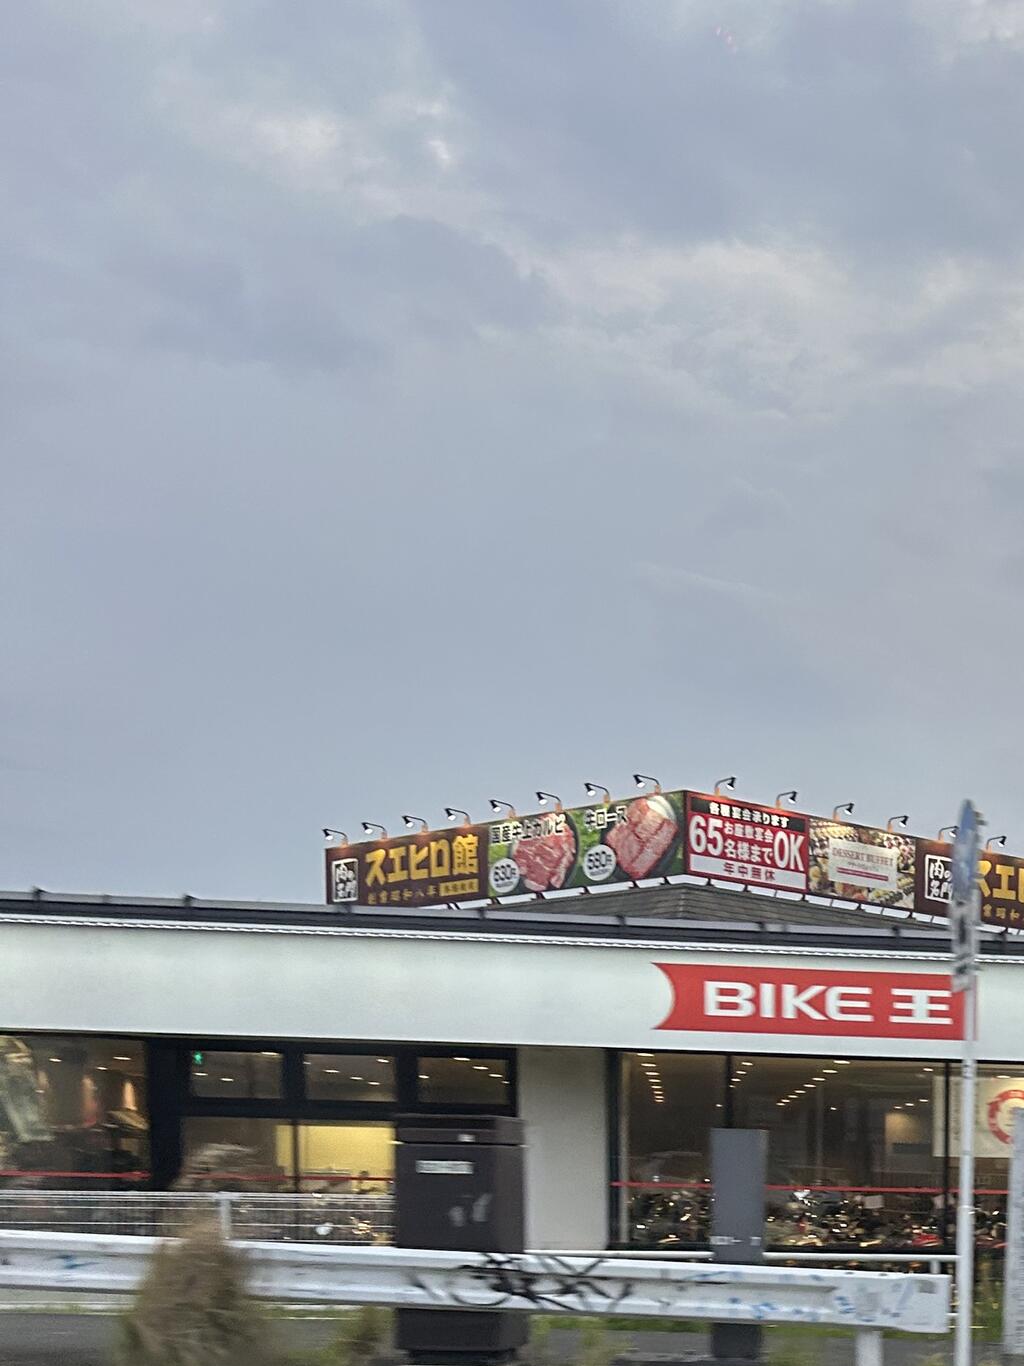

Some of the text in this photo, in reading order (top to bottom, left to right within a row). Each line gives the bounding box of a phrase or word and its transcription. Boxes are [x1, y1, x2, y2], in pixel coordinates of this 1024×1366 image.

[689, 815, 723, 856] 65
[725, 839, 773, 864] 名様まで
[774, 831, 805, 871] OK
[365, 834, 478, 887] スエヒロ館
[723, 862, 775, 881] 年中無休
[704, 981, 953, 1025] BIKE 王
